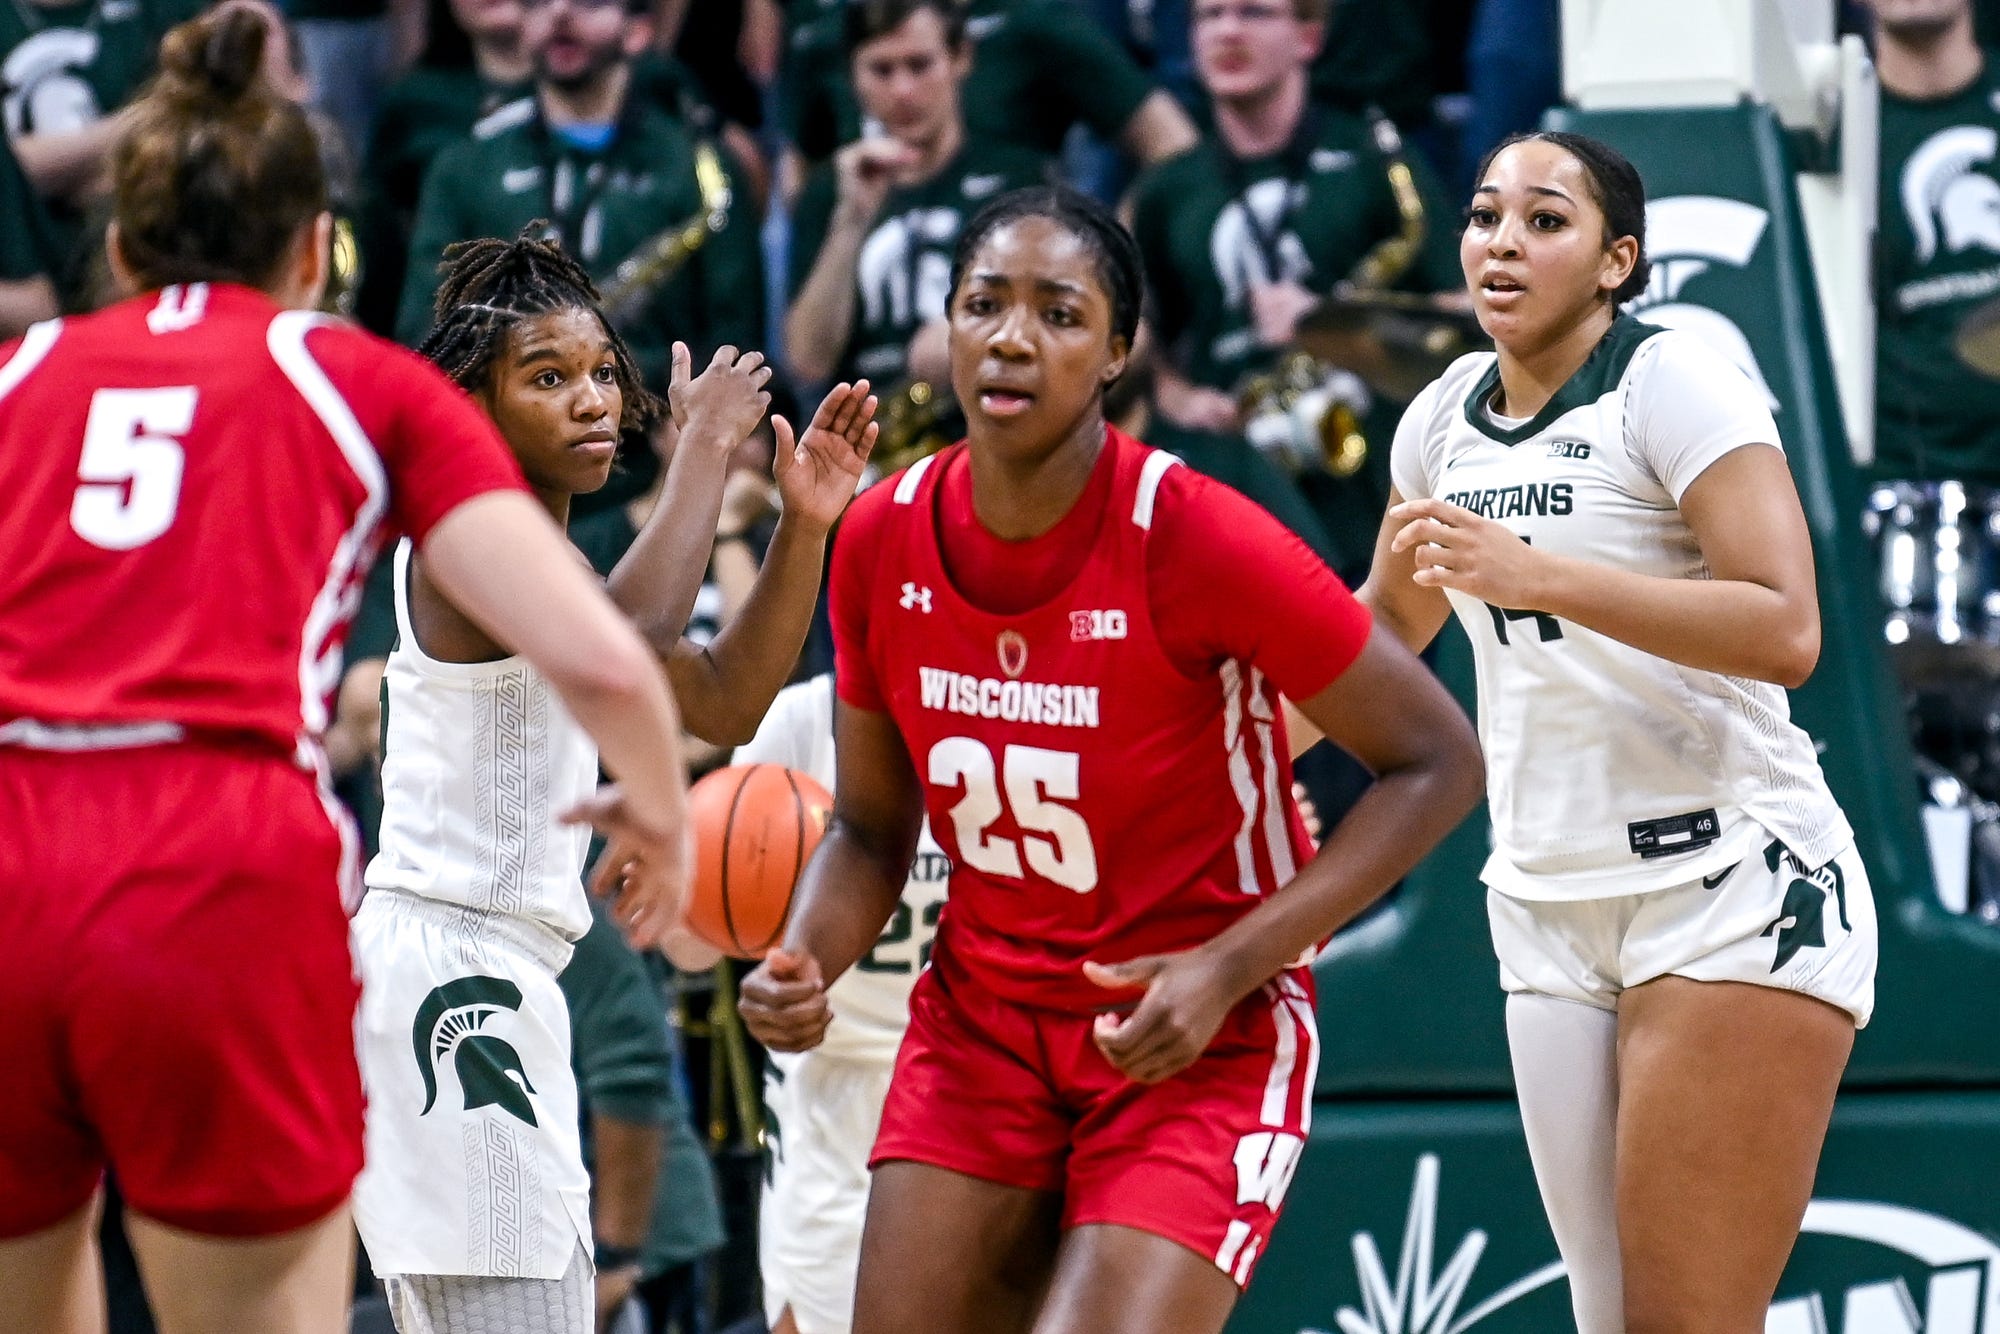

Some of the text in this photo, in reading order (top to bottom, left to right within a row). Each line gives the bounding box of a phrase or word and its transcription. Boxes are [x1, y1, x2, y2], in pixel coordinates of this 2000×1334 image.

[69, 384, 199, 551] 5
[919, 666, 1099, 728] WISCONSIN
[928, 736, 1099, 894] 25
[1696, 818, 1712, 832] 46
